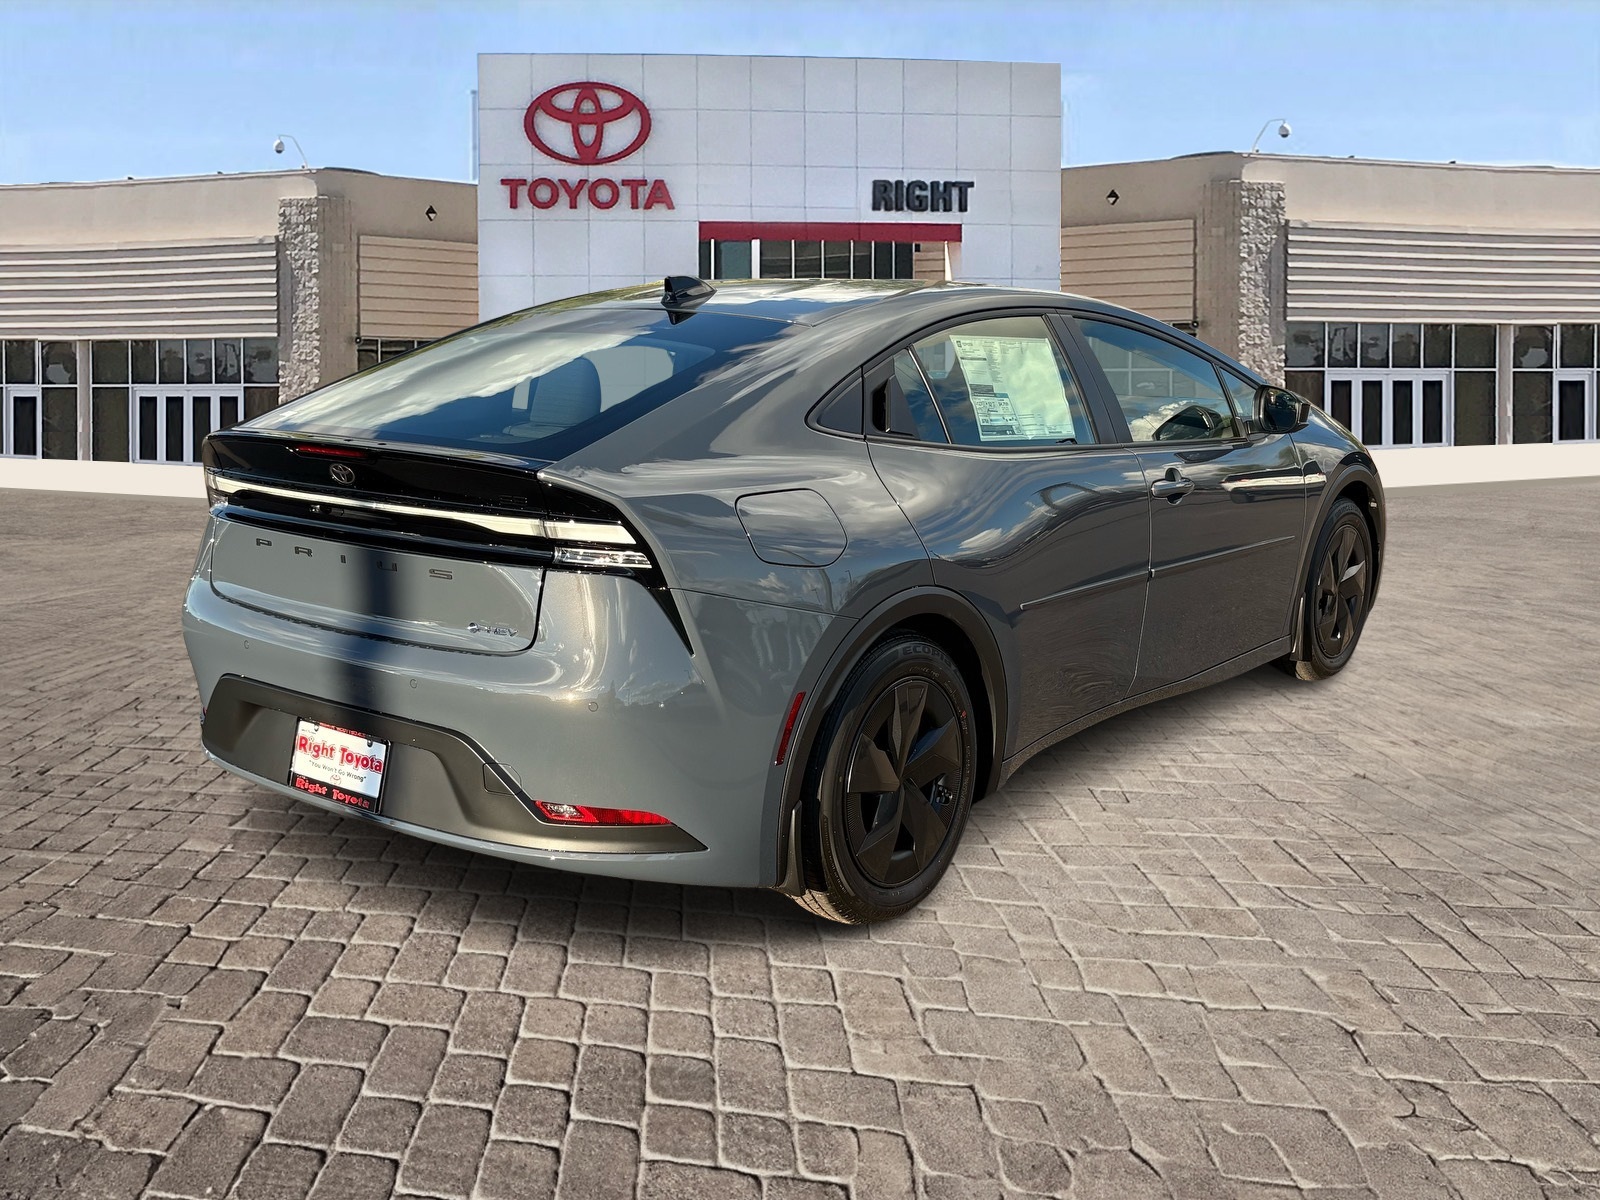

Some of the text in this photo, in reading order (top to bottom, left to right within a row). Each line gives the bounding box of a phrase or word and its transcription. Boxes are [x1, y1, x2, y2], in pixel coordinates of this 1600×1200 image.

[501, 178, 675, 210] TOYOTA
[871, 179, 974, 212] RIGHT
[256, 538, 453, 579] PRIUS
[298, 735, 383, 773] Right Toyota
[296, 777, 370, 808] Right Toyota
